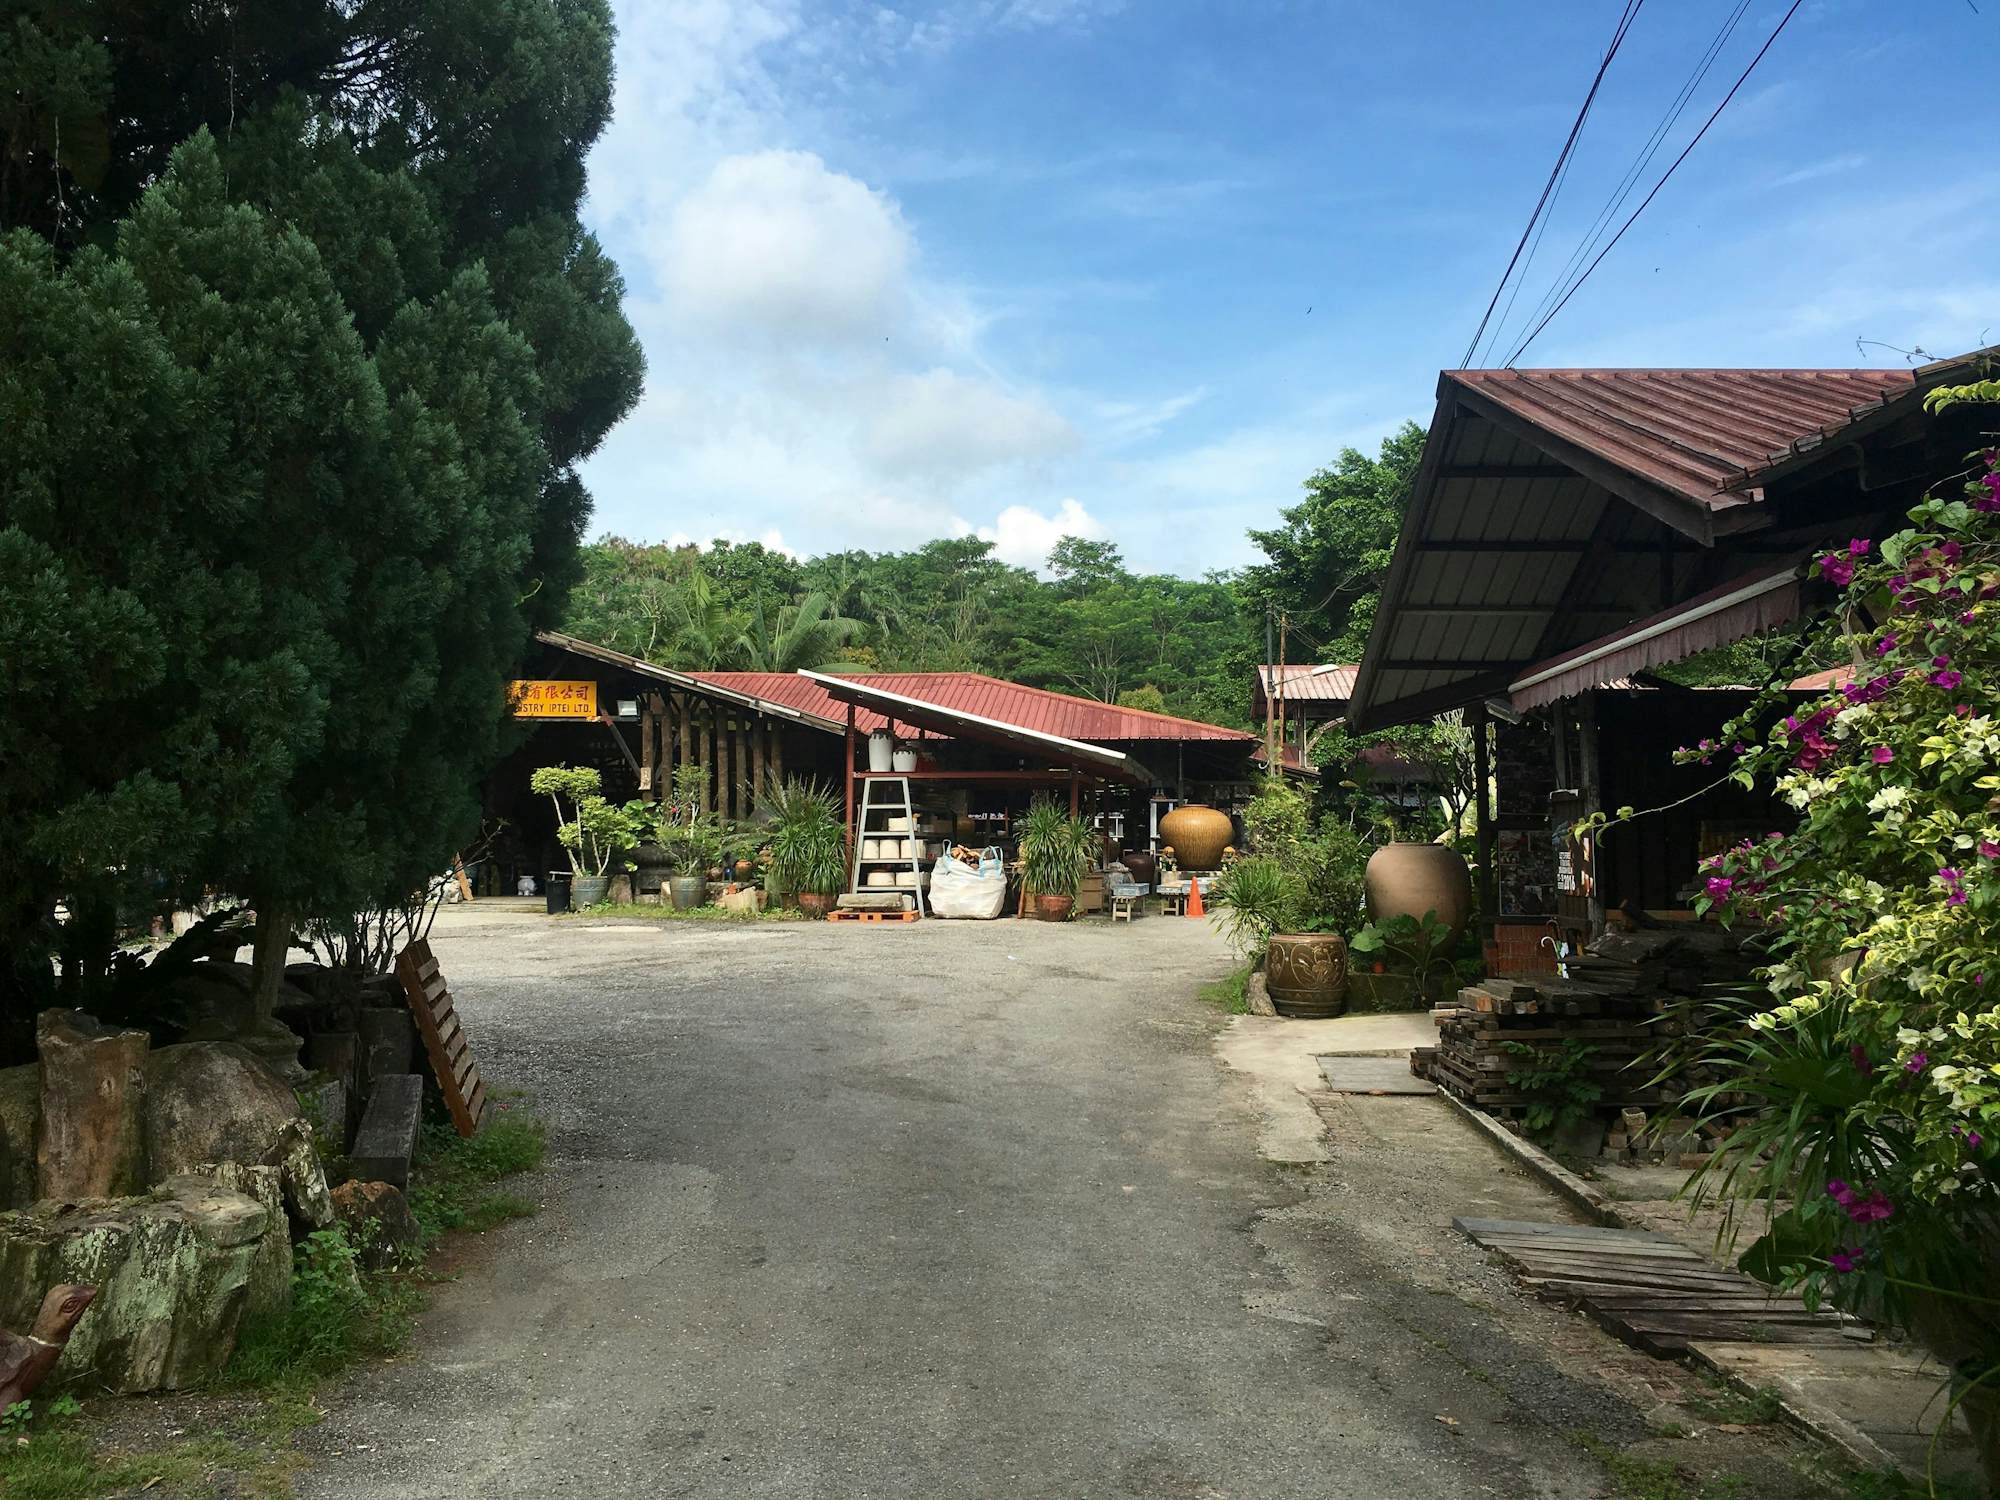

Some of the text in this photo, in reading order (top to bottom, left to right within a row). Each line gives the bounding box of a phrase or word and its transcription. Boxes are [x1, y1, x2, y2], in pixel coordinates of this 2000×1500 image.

[520, 685, 589, 700] 有限公司
[574, 704, 592, 713] LTD.
